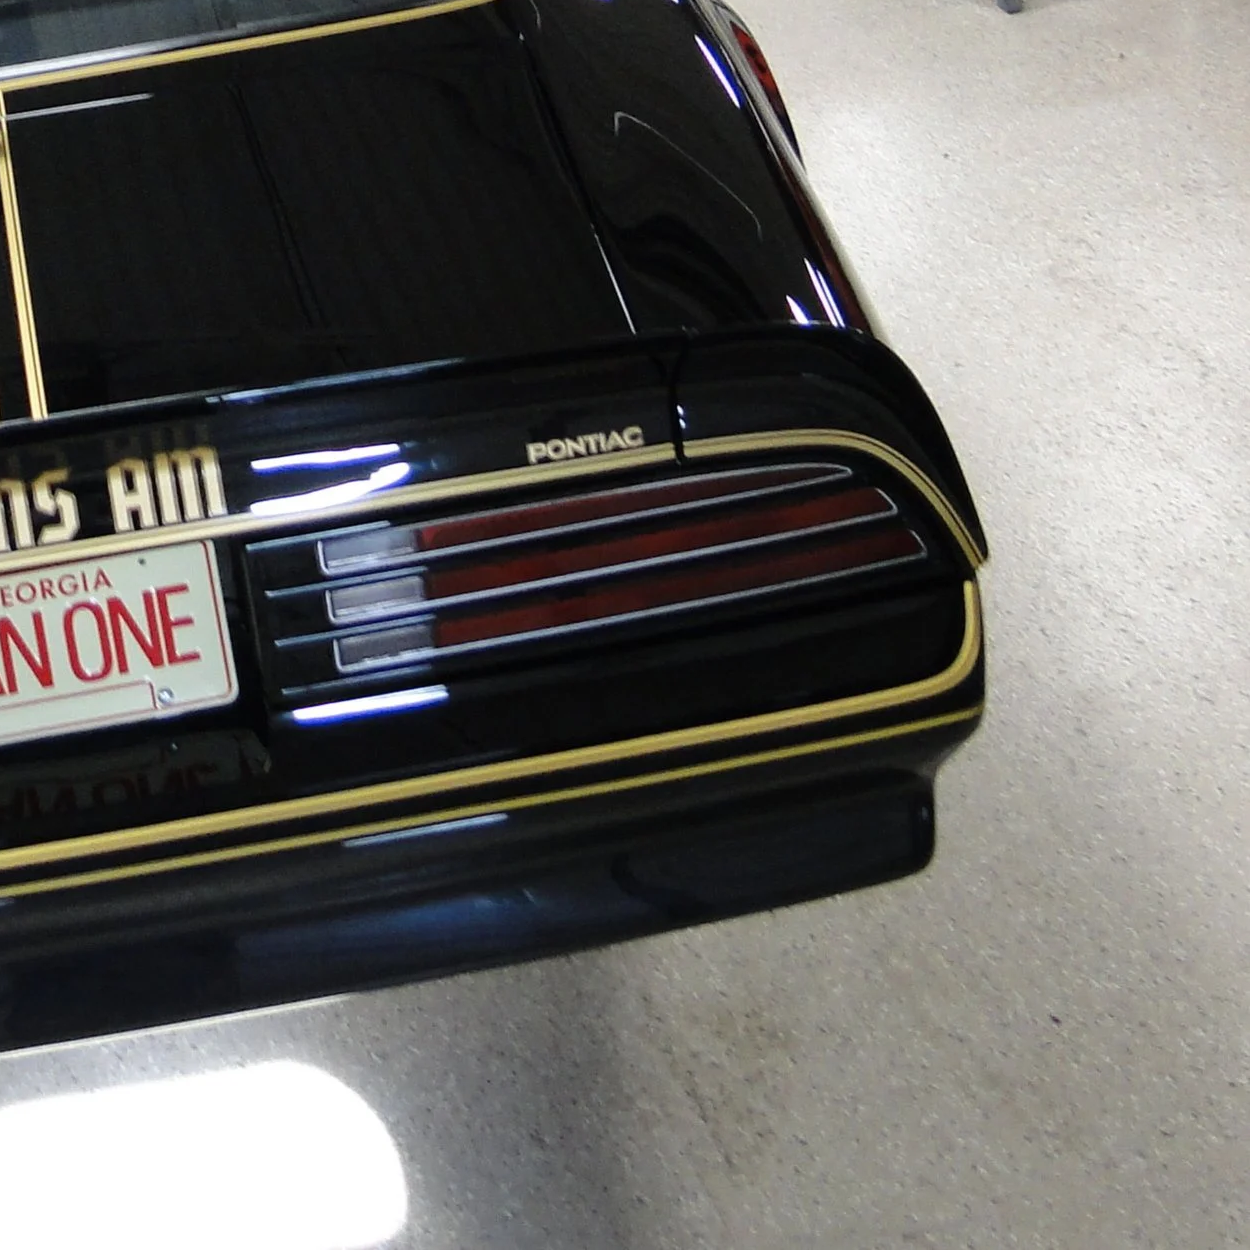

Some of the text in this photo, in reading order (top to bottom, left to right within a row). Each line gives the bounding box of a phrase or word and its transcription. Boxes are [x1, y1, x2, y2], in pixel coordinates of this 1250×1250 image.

[526, 425, 646, 465] PONTIAC
[105, 446, 228, 534] AM
[63, 583, 200, 683] ONE
